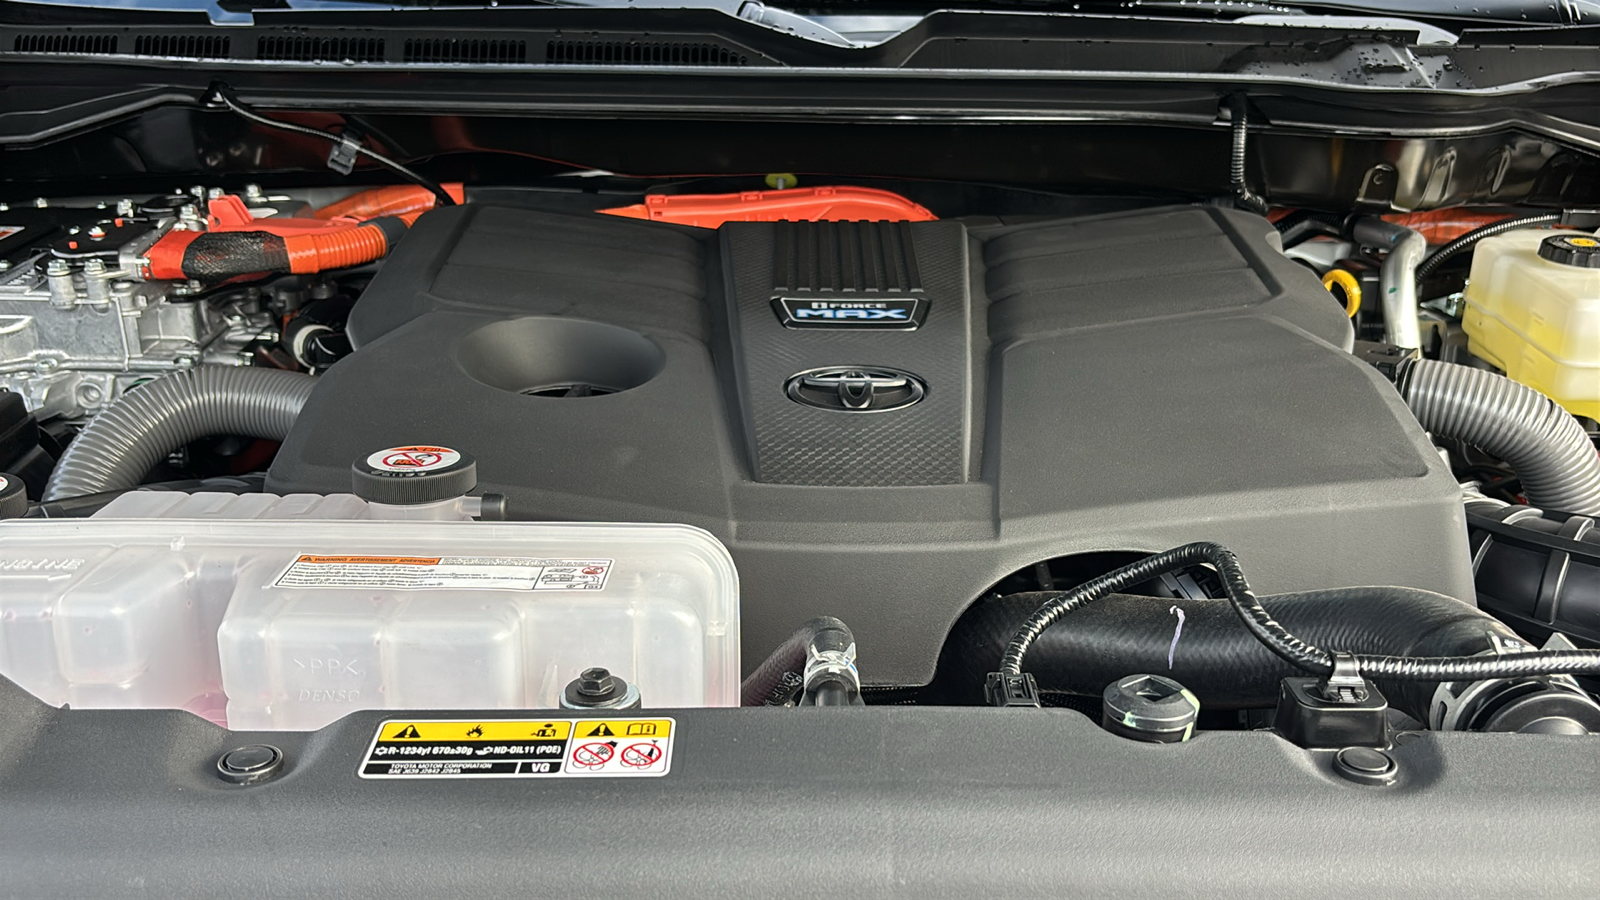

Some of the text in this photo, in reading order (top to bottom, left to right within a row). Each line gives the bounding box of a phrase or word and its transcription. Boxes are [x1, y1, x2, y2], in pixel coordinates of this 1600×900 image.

[796, 309, 907, 319] MAX
[298, 689, 361, 702] DENSO
[536, 745, 562, 755] (POE)
[443, 762, 493, 770] CORPORATION
[531, 762, 551, 773] VG
